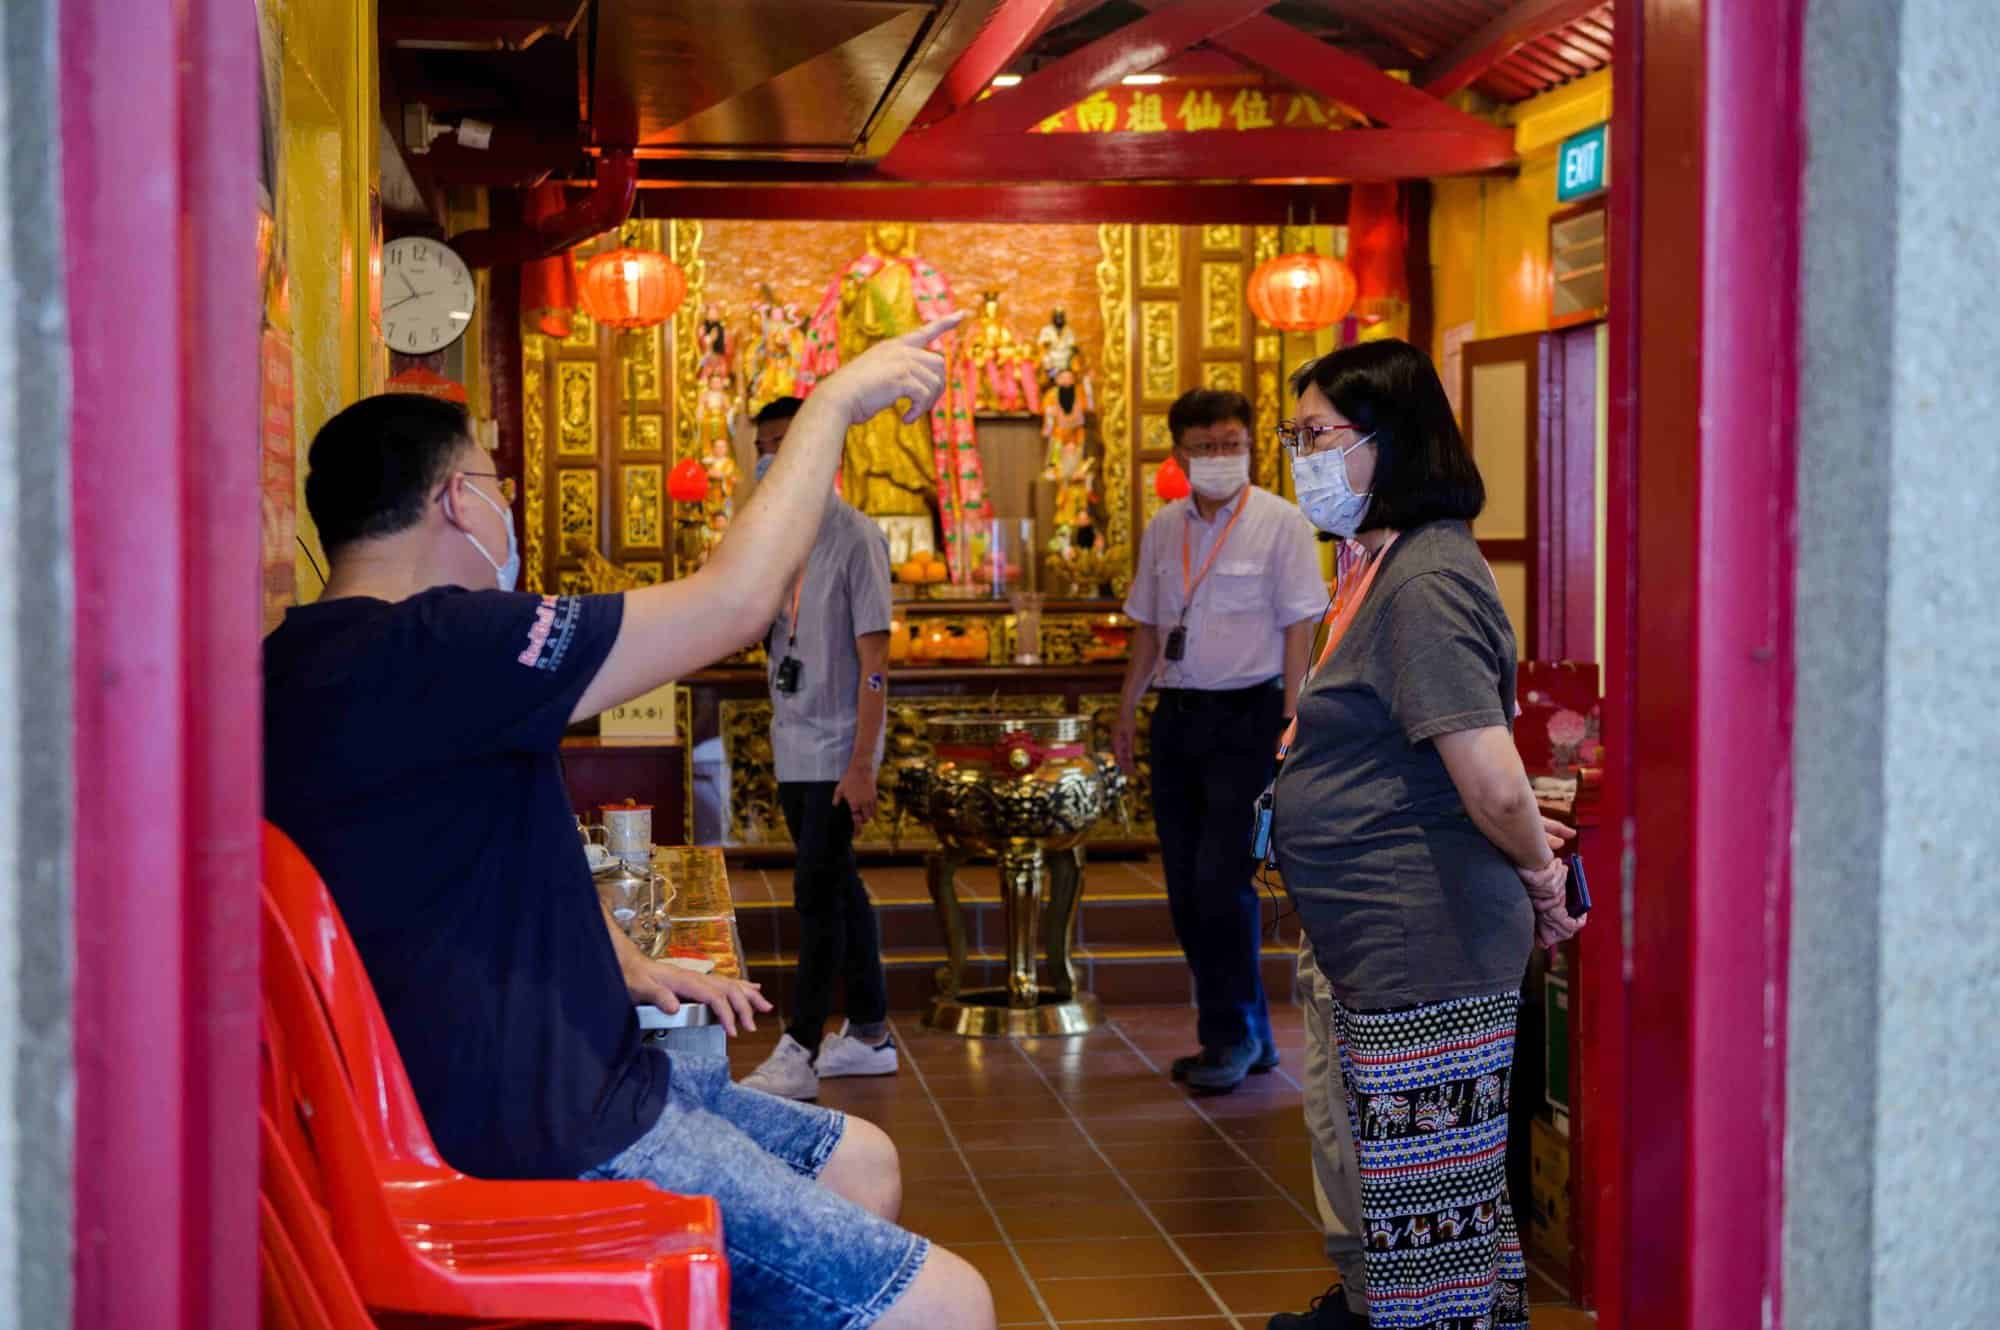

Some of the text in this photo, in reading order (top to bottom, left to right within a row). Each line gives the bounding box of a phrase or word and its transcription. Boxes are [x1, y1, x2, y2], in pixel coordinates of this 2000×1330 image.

[1565, 141, 1599, 189] EXIT
[391, 248, 402, 265] 11
[413, 245, 426, 261] 12
[452, 269, 462, 285] 2
[387, 322, 396, 340] 7
[408, 330, 417, 347] 6
[431, 326, 440, 344] 5
